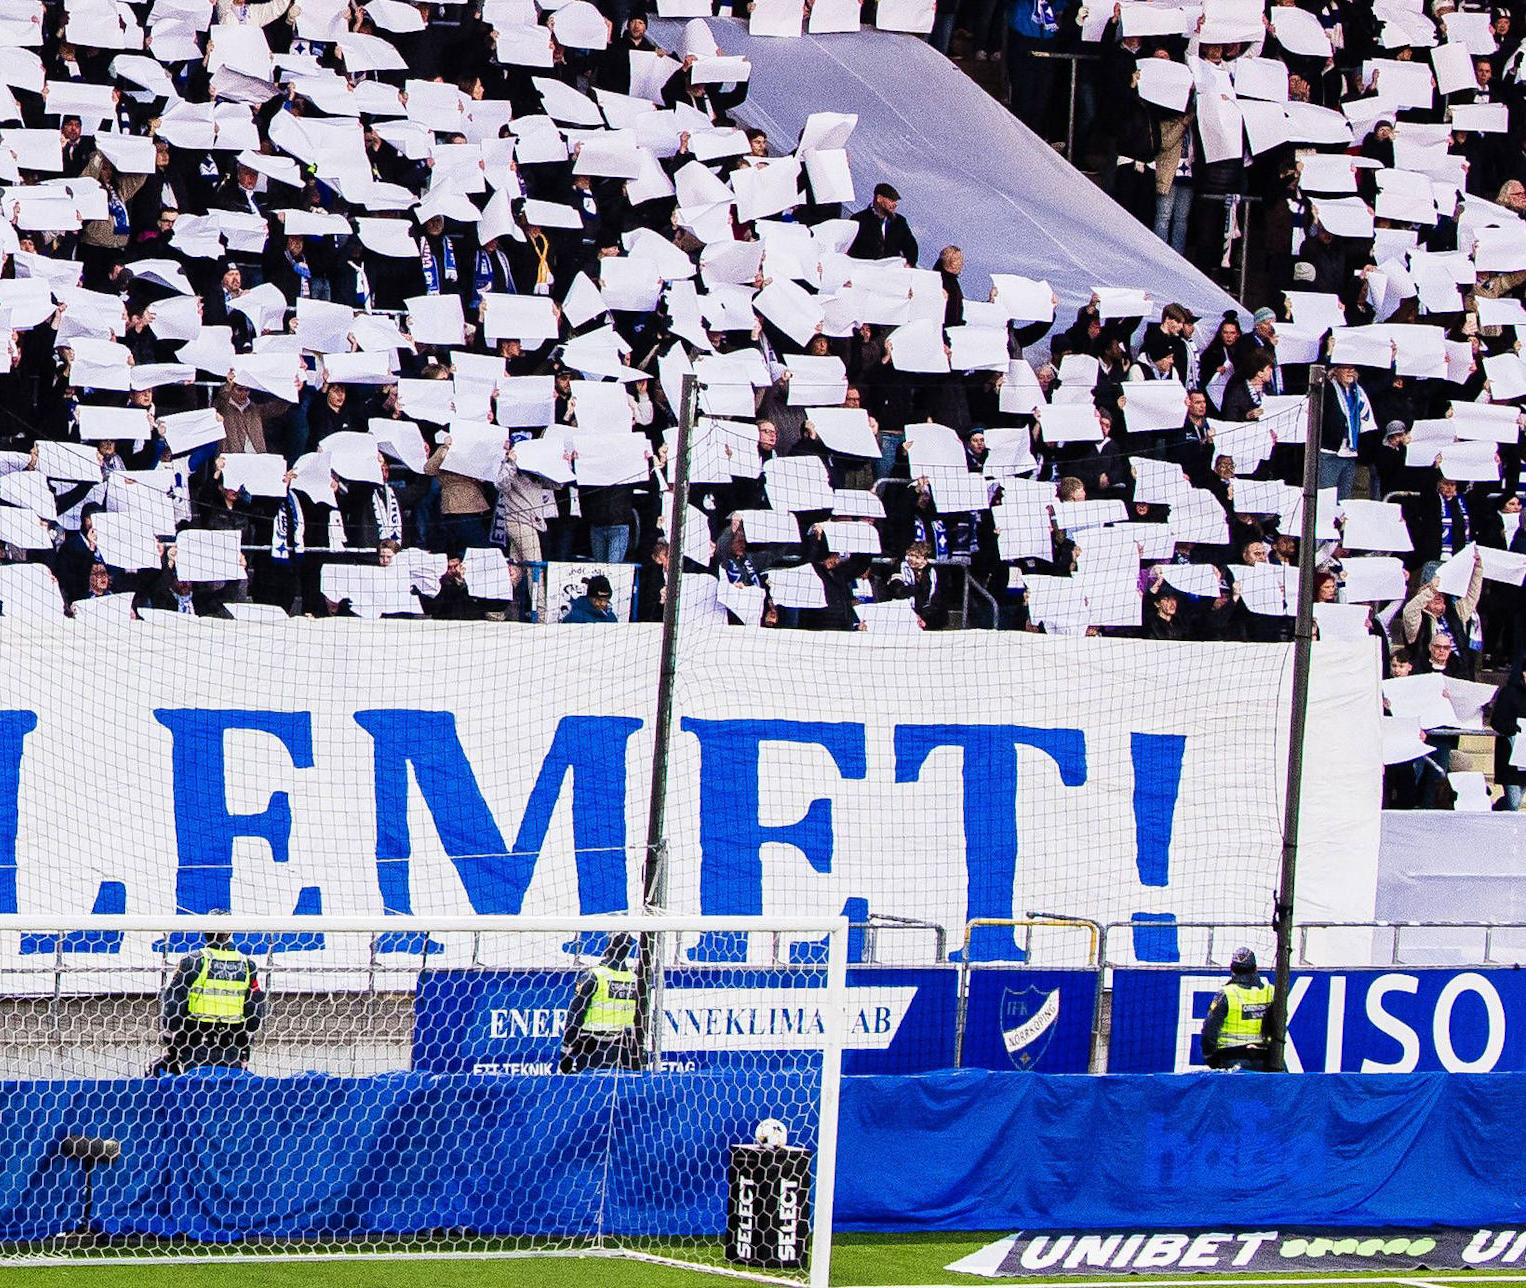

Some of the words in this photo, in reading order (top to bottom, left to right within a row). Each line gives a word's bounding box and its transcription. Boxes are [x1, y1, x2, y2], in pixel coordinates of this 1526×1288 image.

[855, 1005, 892, 1035] AB
[736, 1174, 755, 1259] SELECT
[777, 1178, 799, 1261] SELECT
[1020, 1231, 1278, 1268] UNIBET
